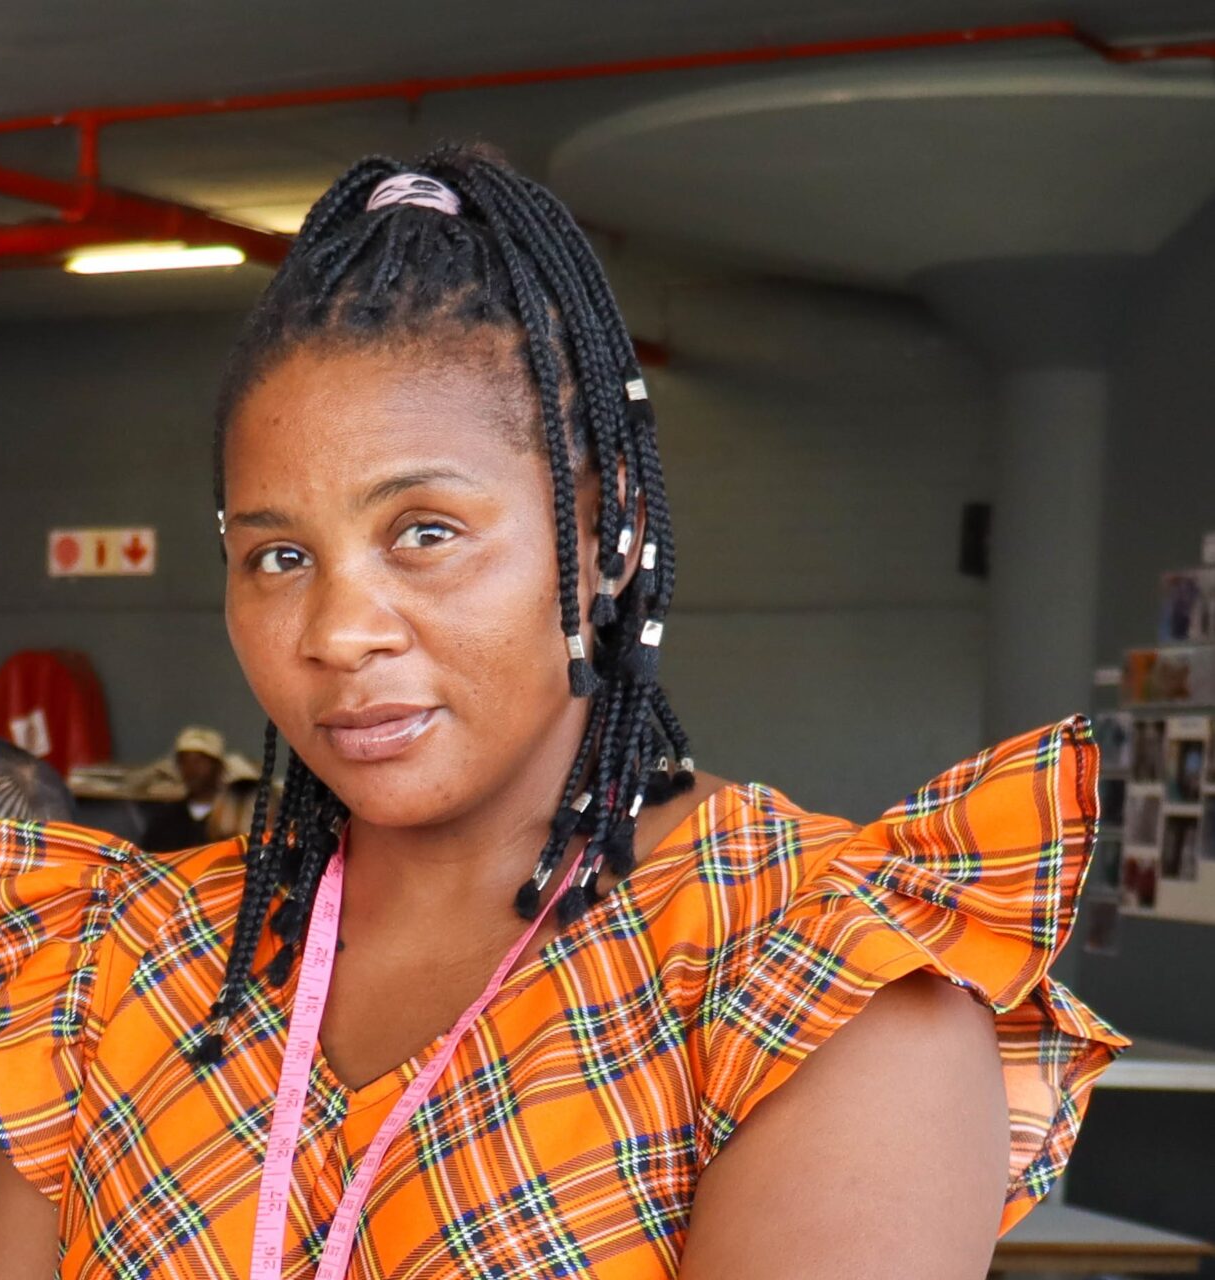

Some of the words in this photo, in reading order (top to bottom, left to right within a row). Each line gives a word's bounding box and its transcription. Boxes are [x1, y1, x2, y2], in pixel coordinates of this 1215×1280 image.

[323, 902, 335, 921] 33
[314, 947, 328, 968] 32
[306, 995, 319, 1013] 31
[297, 1040, 310, 1060] 30
[287, 1088, 301, 1108] 29
[277, 1137, 290, 1158] 28
[269, 1191, 283, 1211] 27
[264, 1246, 276, 1269] 26
